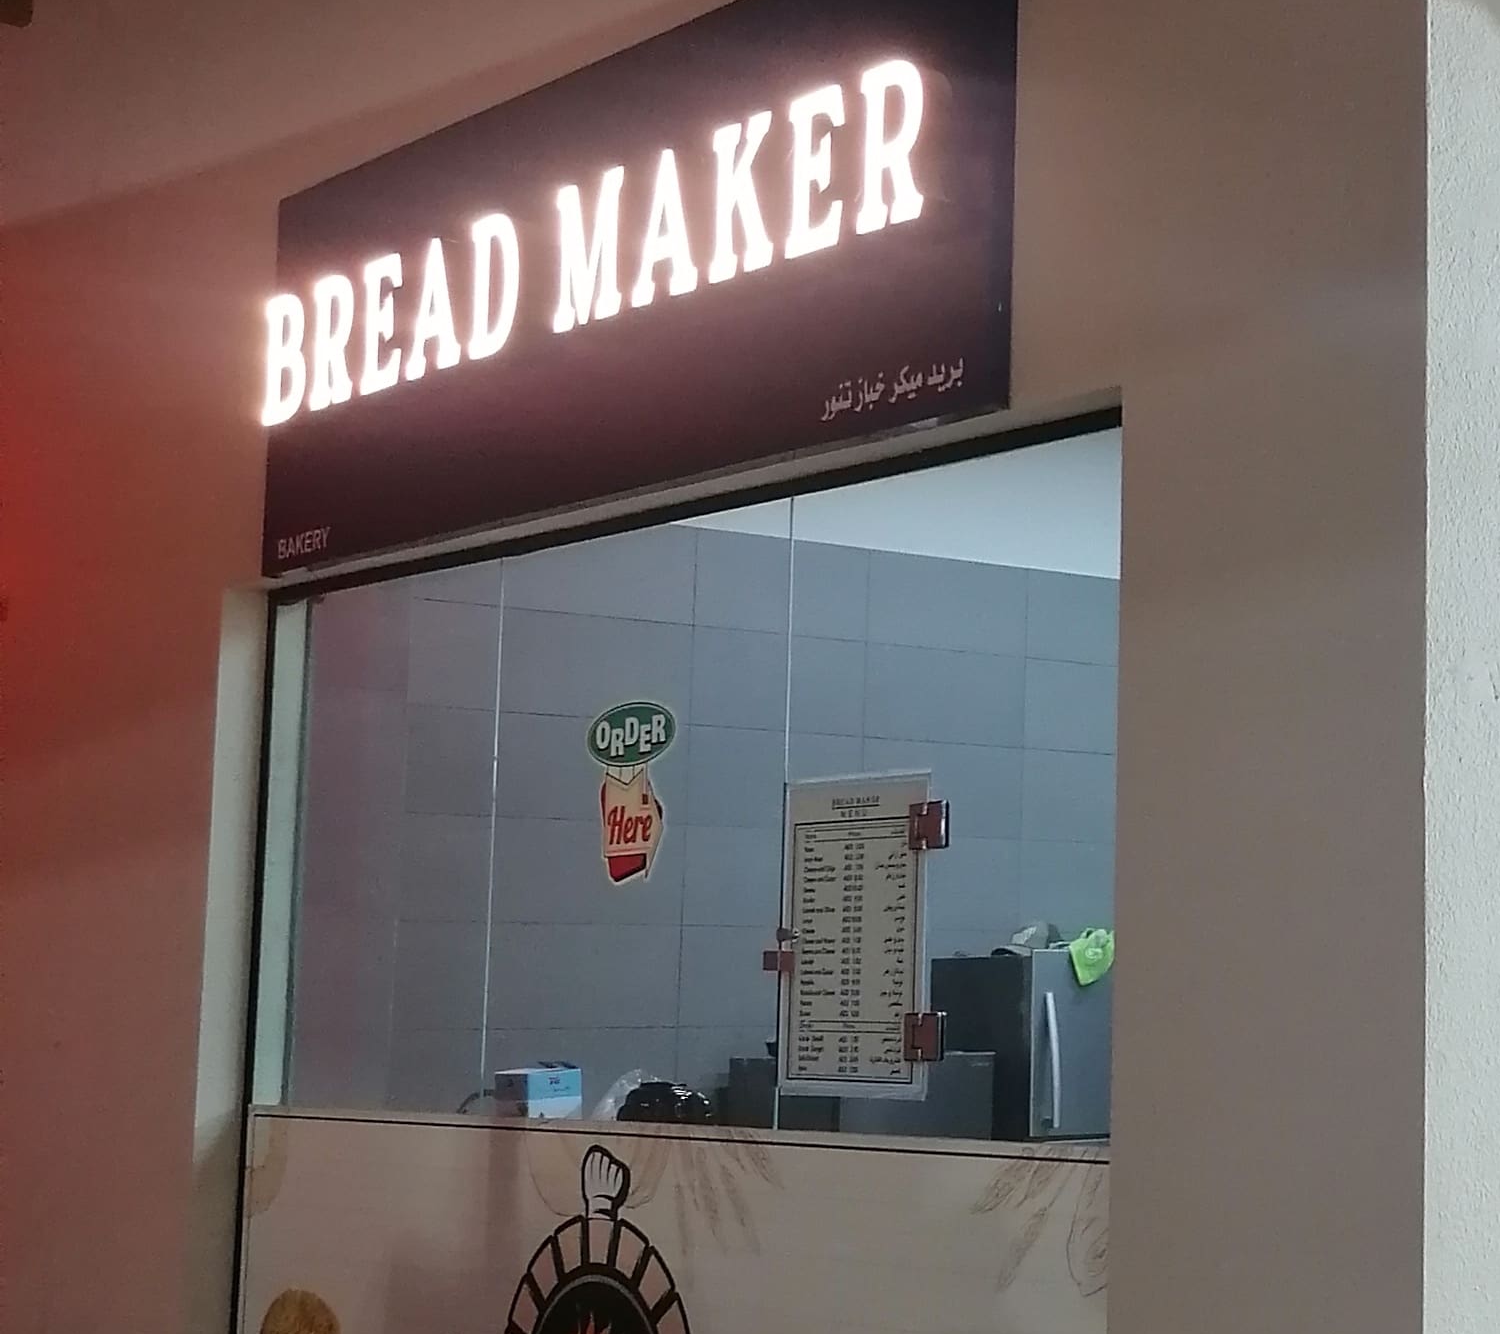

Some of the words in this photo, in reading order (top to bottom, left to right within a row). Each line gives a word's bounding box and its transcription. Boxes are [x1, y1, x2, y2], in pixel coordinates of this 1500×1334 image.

[260, 213, 519, 427] BREAD
[553, 59, 924, 334] MAKER
[854, 371, 885, 412] خباز
[888, 365, 923, 403] ميكر
[927, 357, 964, 392] بريد
[821, 381, 852, 421] تنور
[278, 526, 331, 559] BAKERY
[595, 713, 667, 758] ORDER
[608, 805, 652, 845] Here
